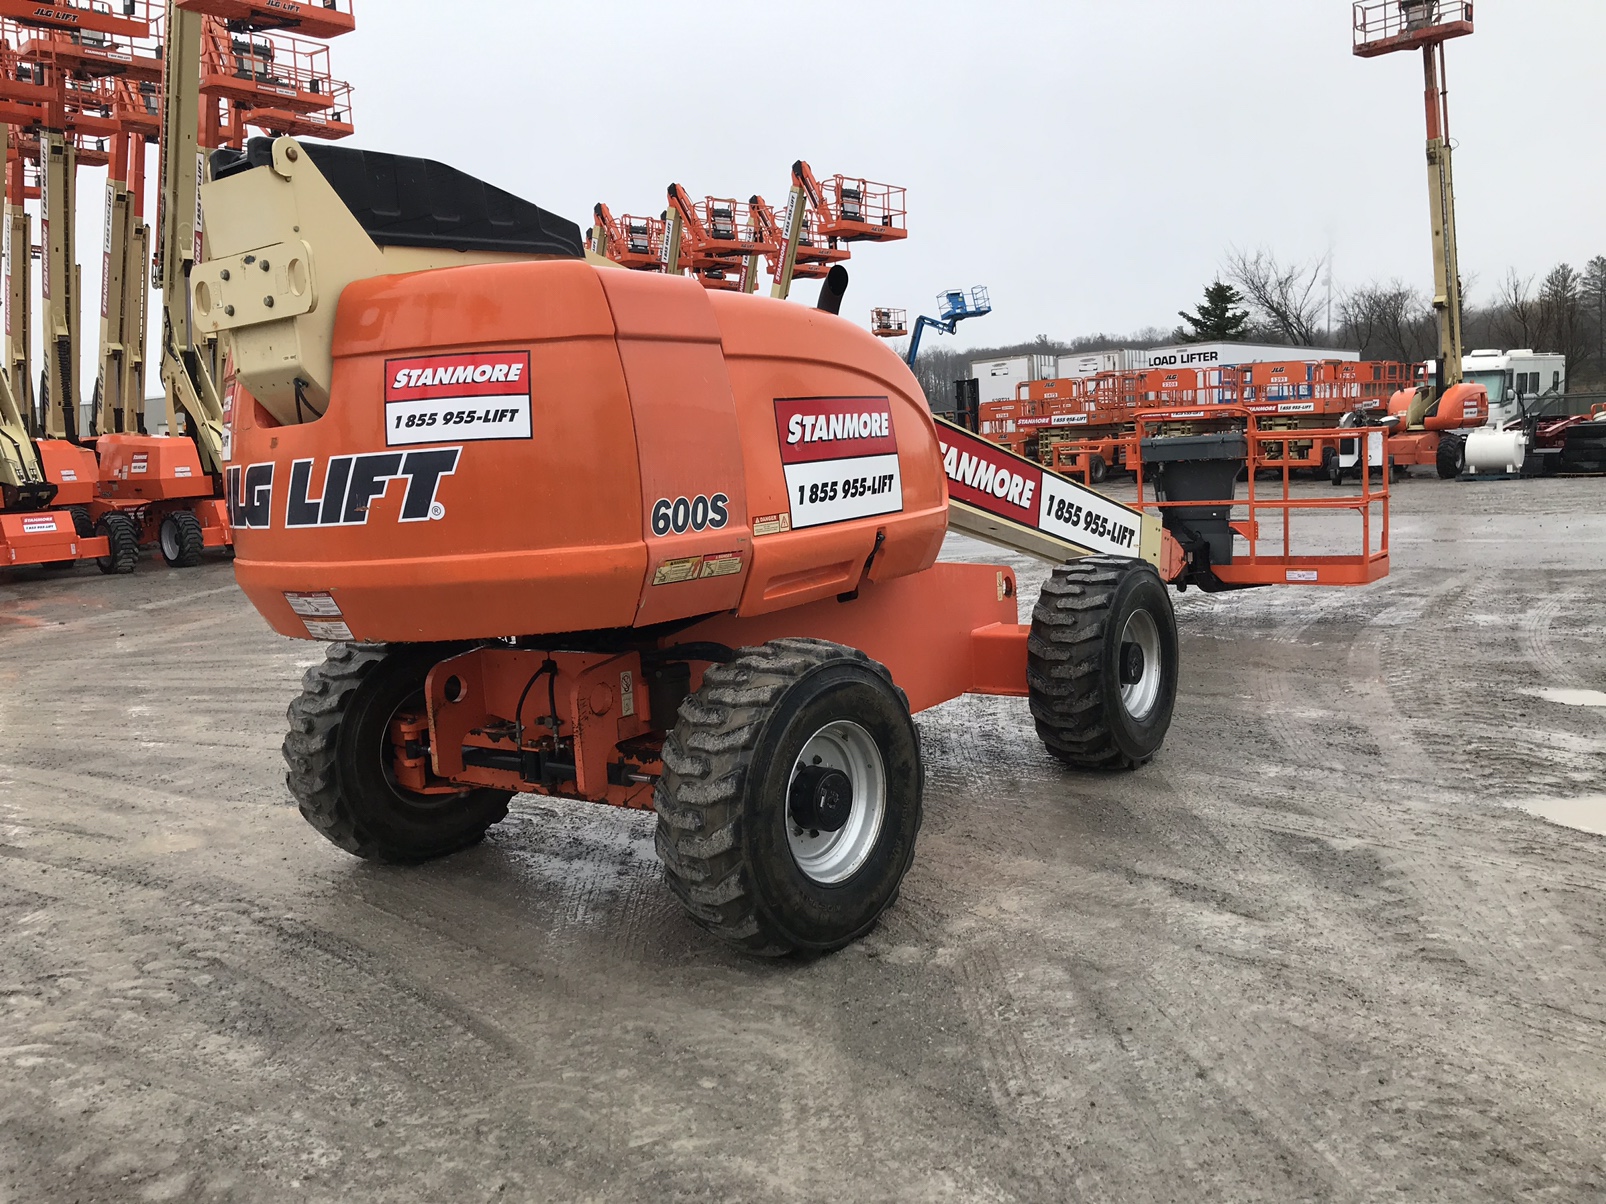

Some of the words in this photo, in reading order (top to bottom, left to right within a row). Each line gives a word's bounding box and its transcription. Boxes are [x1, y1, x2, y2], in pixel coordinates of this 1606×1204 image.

[33, 8, 54, 18] JLG
[55, 10, 79, 22] LIFT
[283, 3, 300, 13] LIFT
[775, 240, 787, 281] STANMORE
[1148, 355, 1177, 367] LOAD
[1180, 351, 1219, 364] LIFTER
[392, 363, 524, 389] STANMORE
[394, 415, 403, 429] 1
[404, 412, 439, 429] 855
[442, 408, 520, 426] 955-LIFT
[786, 412, 890, 445] STANMORE
[1017, 417, 1050, 425] STANMORE
[285, 446, 464, 529] LIFT
[798, 485, 805, 505] 1
[808, 481, 839, 504] 855
[841, 474, 895, 500] 955-LIFT
[939, 441, 1036, 509] ANMORE
[1046, 494, 1056, 517] 1
[1054, 498, 1083, 527] 855
[1082, 510, 1136, 549] 955-LIFT
[651, 492, 730, 537] 600S
